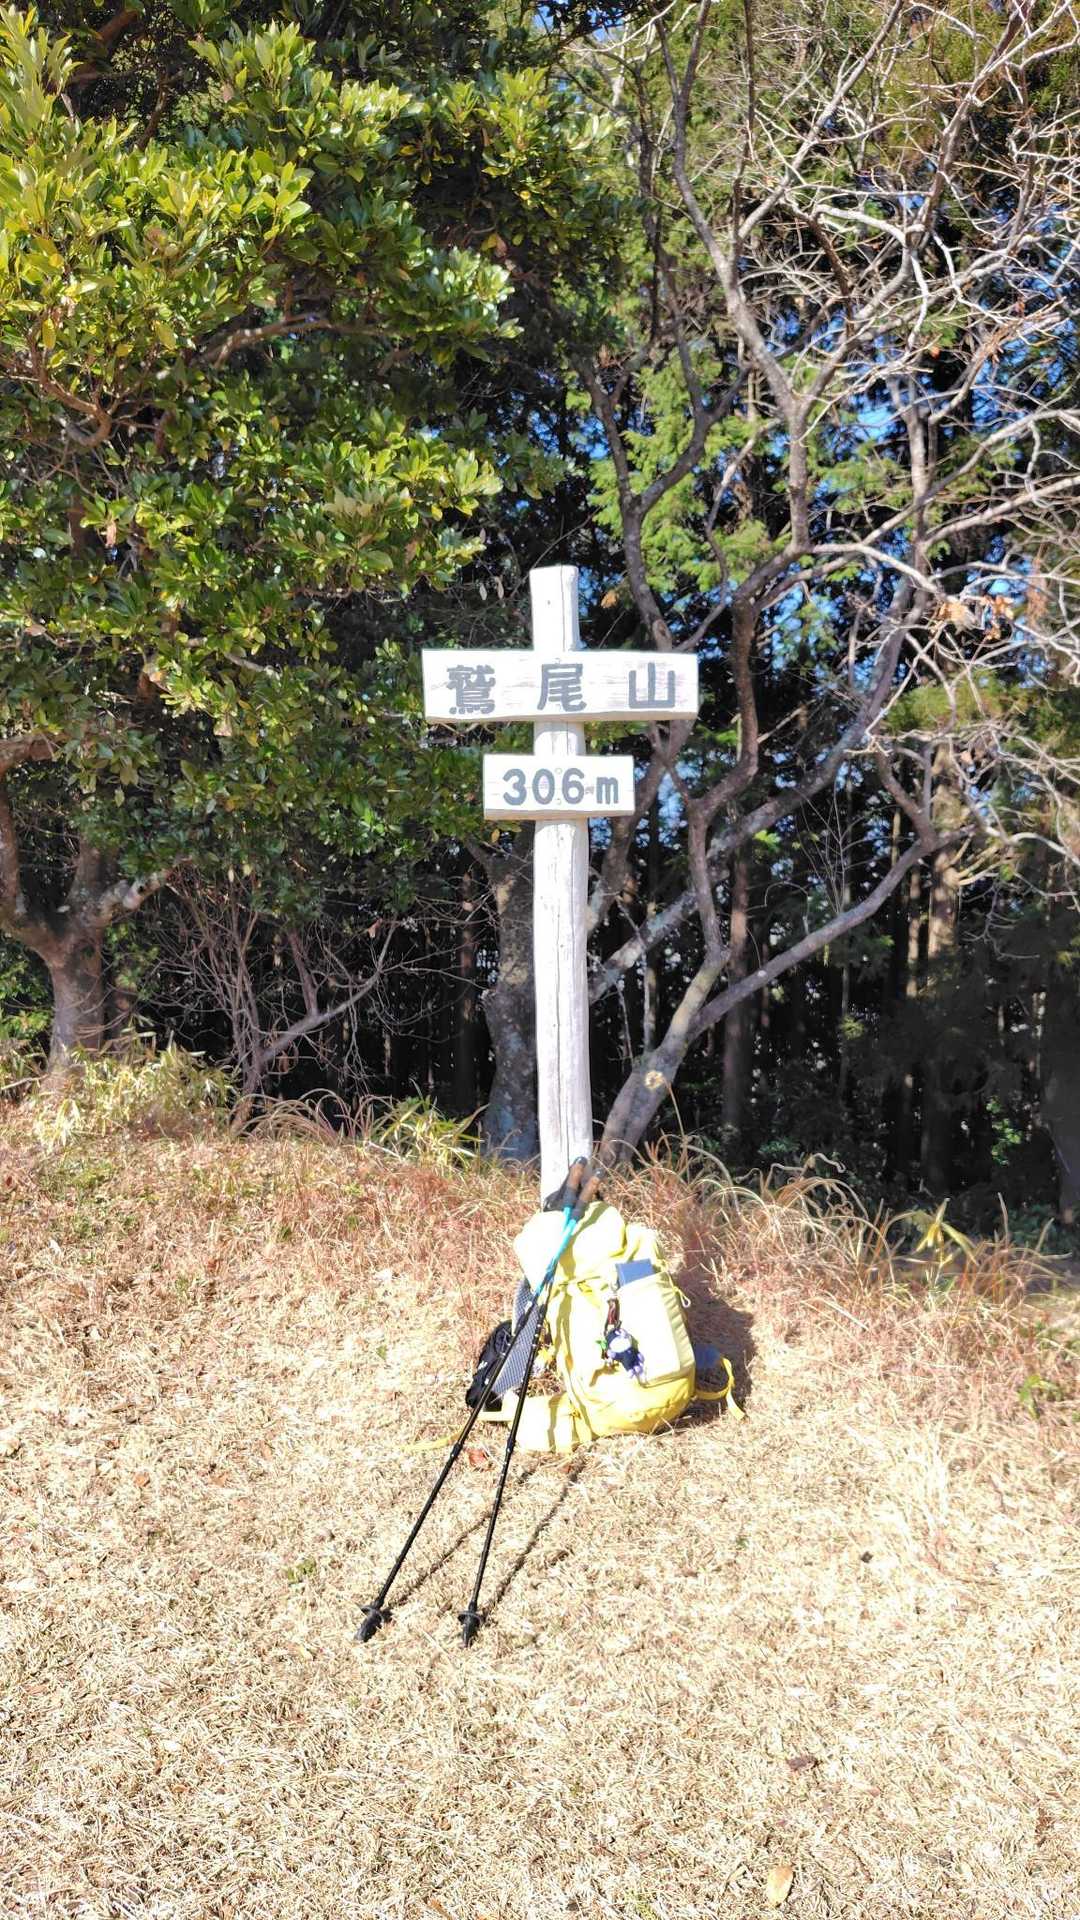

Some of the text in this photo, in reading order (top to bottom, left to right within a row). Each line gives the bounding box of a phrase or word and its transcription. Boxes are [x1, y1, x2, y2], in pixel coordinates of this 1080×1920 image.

[446, 662, 676, 714] 鷲尾山
[502, 768, 619, 806] 306m
